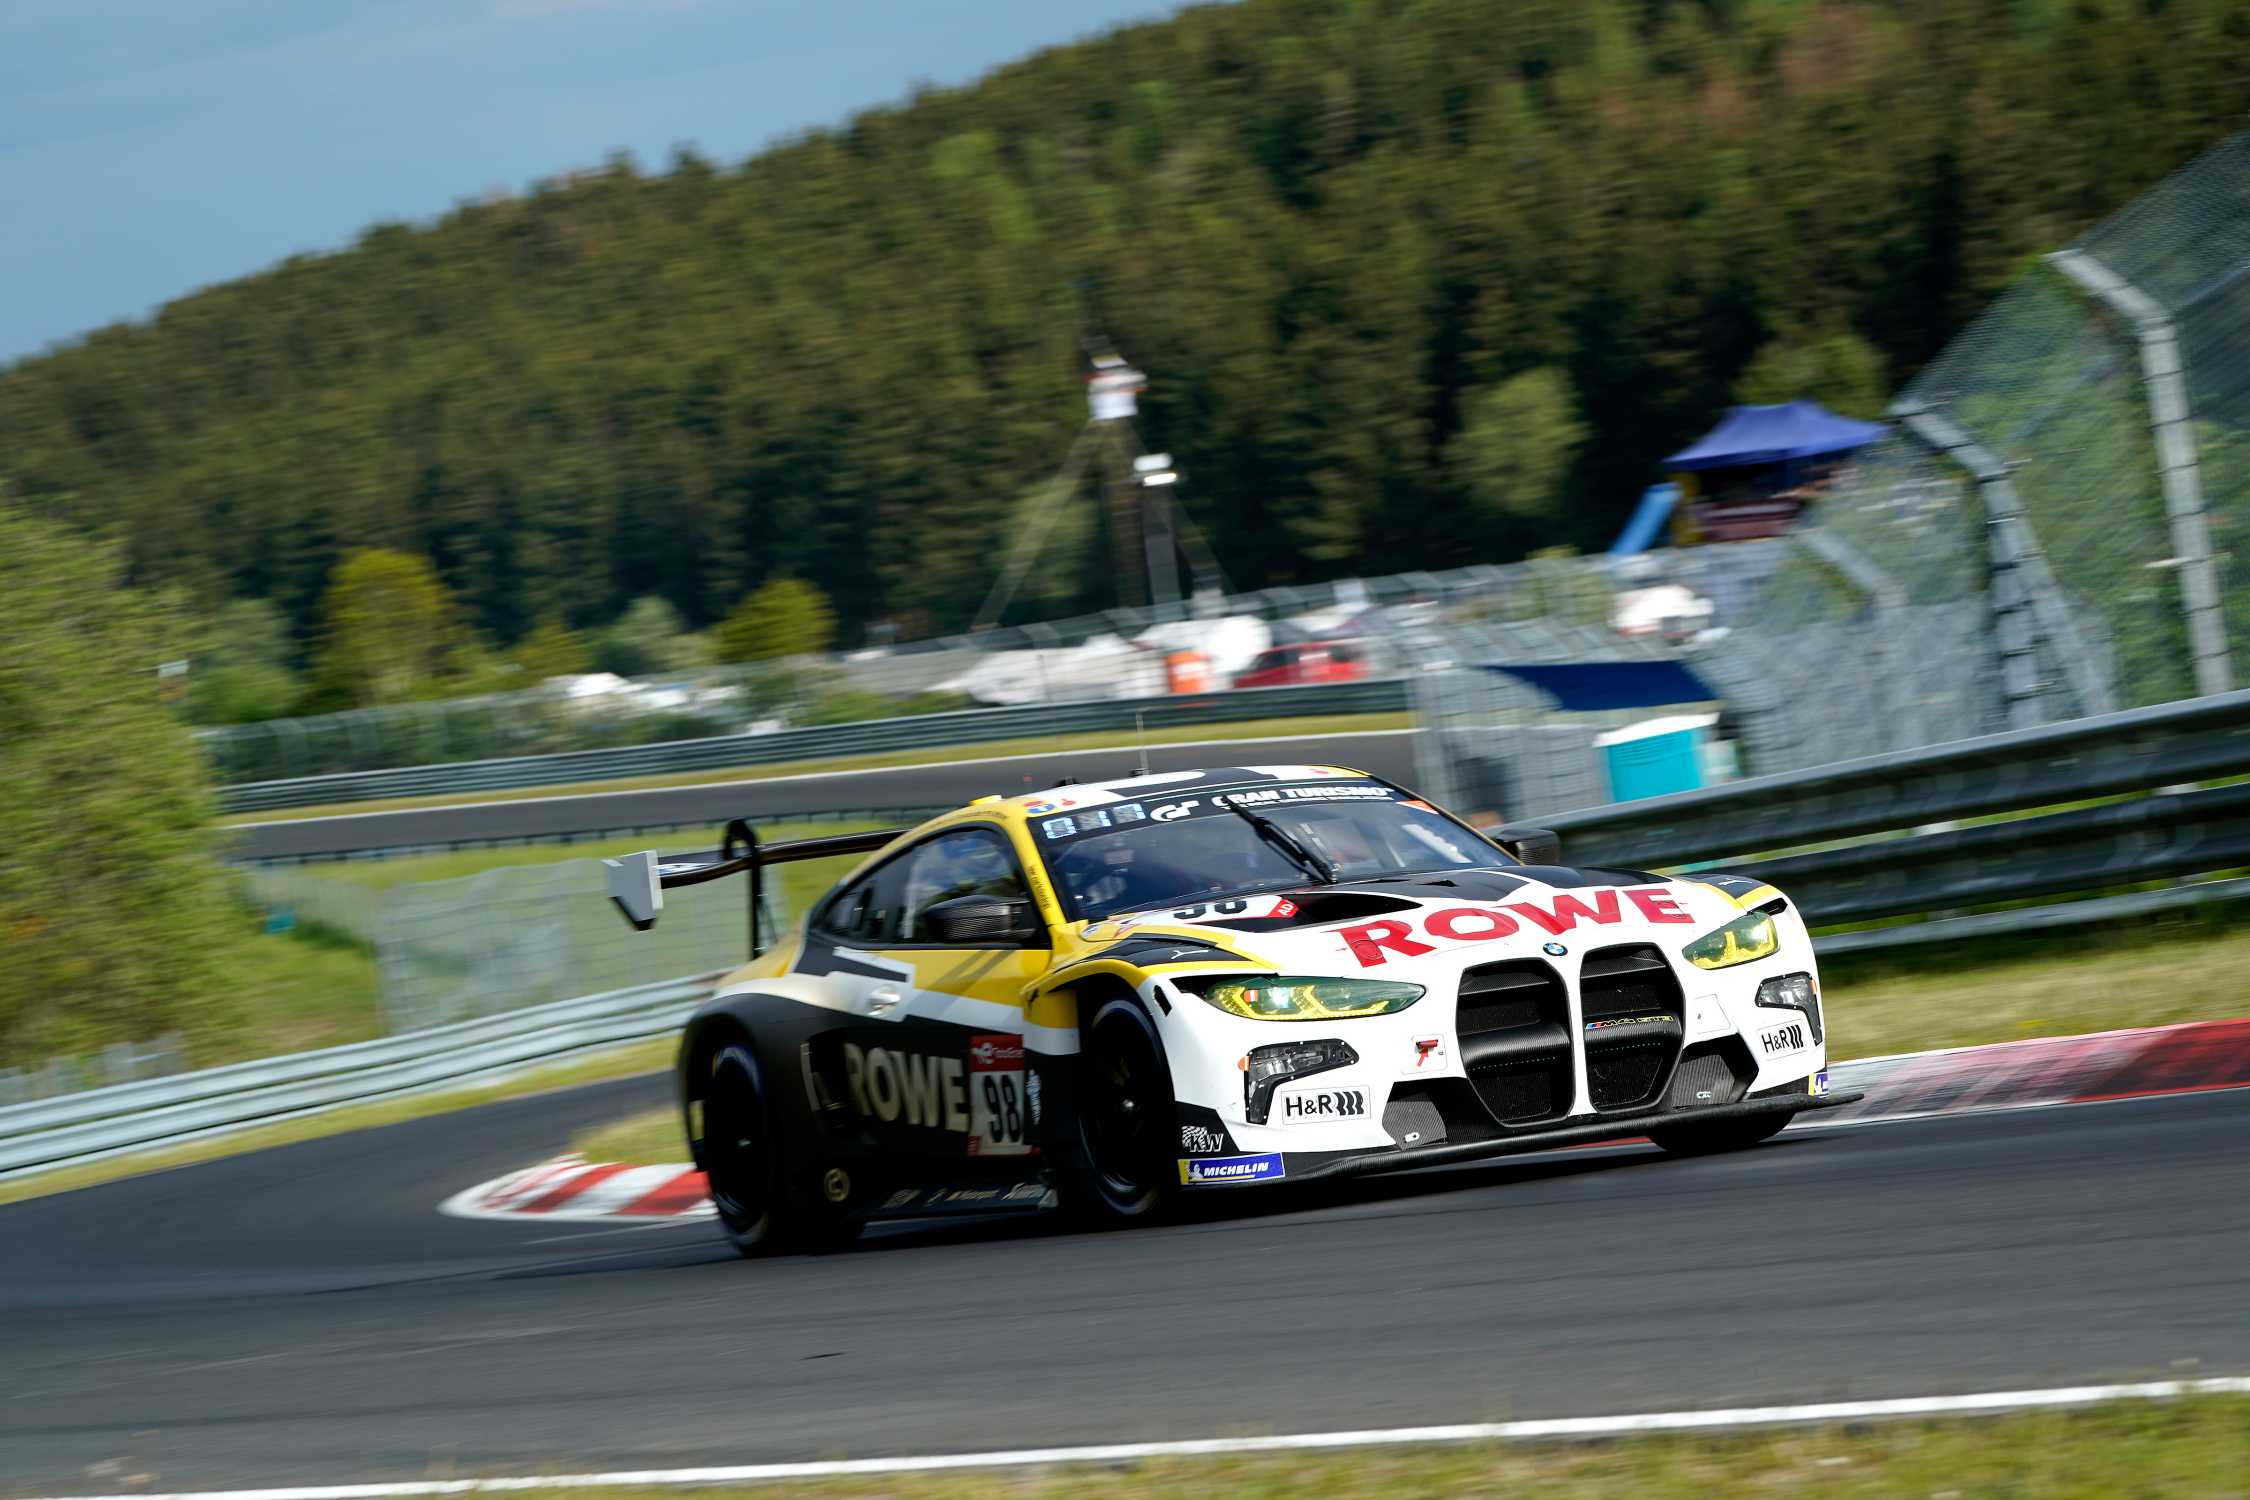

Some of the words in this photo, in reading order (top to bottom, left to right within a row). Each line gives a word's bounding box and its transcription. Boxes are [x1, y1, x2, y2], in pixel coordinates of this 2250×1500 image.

[1211, 790, 1280, 807] GRAN
[1281, 787, 1393, 799] TURISMO
[1278, 900, 1295, 916] AD
[1337, 889, 1695, 967] ROWE
[1761, 1029, 1790, 1053] H&R
[843, 1042, 970, 1132] ROWE
[983, 1074, 1021, 1142] 98
[1285, 1094, 1333, 1117] H&R
[1189, 1133, 1223, 1152] KW
[1203, 1162, 1269, 1177] MICHELIN
